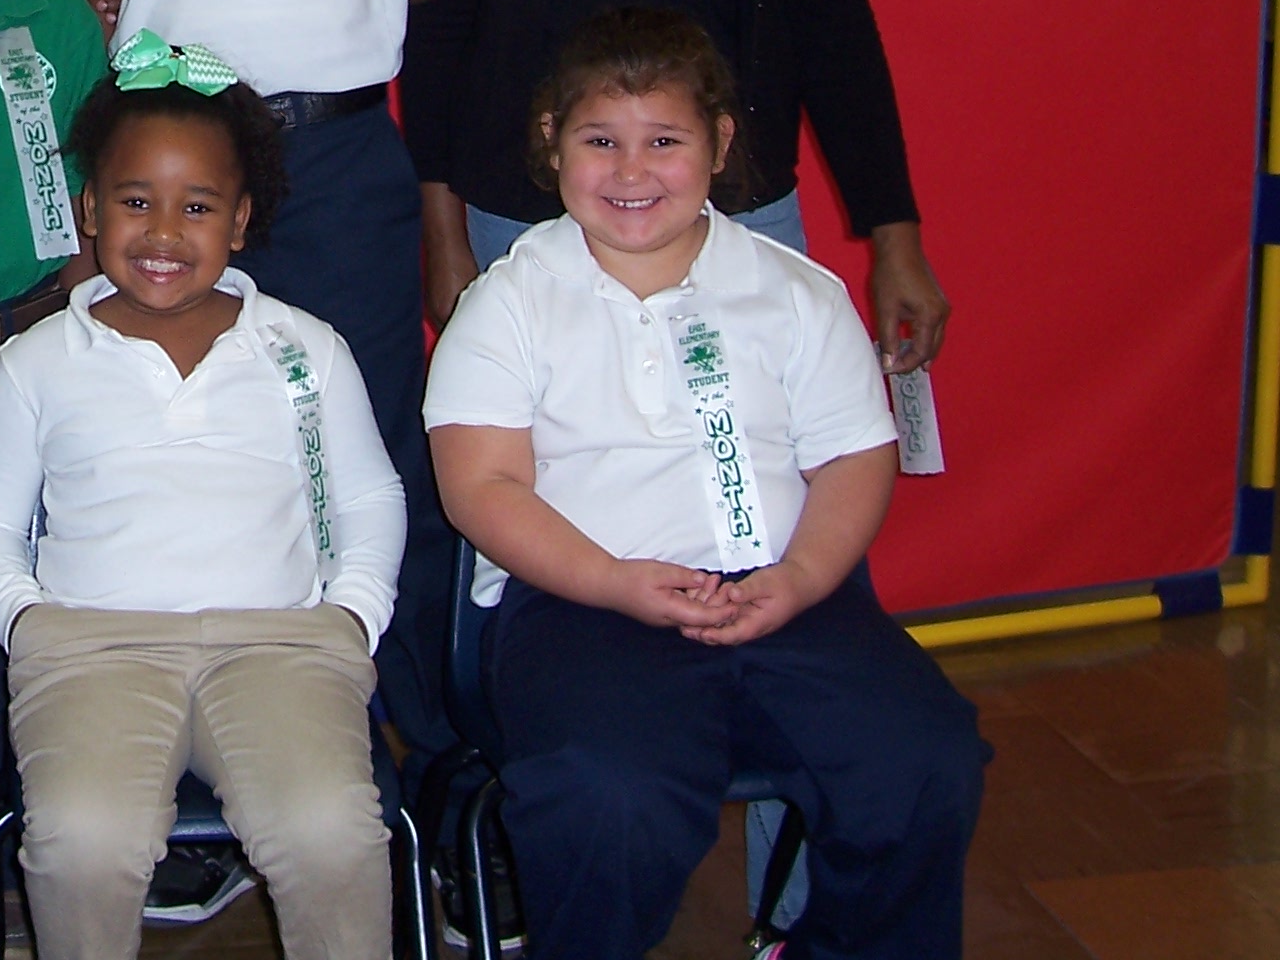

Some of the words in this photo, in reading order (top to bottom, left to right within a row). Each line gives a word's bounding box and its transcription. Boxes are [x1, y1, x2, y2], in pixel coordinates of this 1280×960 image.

[9, 90, 45, 103] STUDENT
[23, 120, 63, 231] MONTH
[688, 322, 706, 335] EAST
[678, 330, 721, 345] ELEMENTARY
[687, 372, 729, 389] STUDENT
[703, 408, 752, 538] MONTH
[303, 426, 330, 551] MONTH
